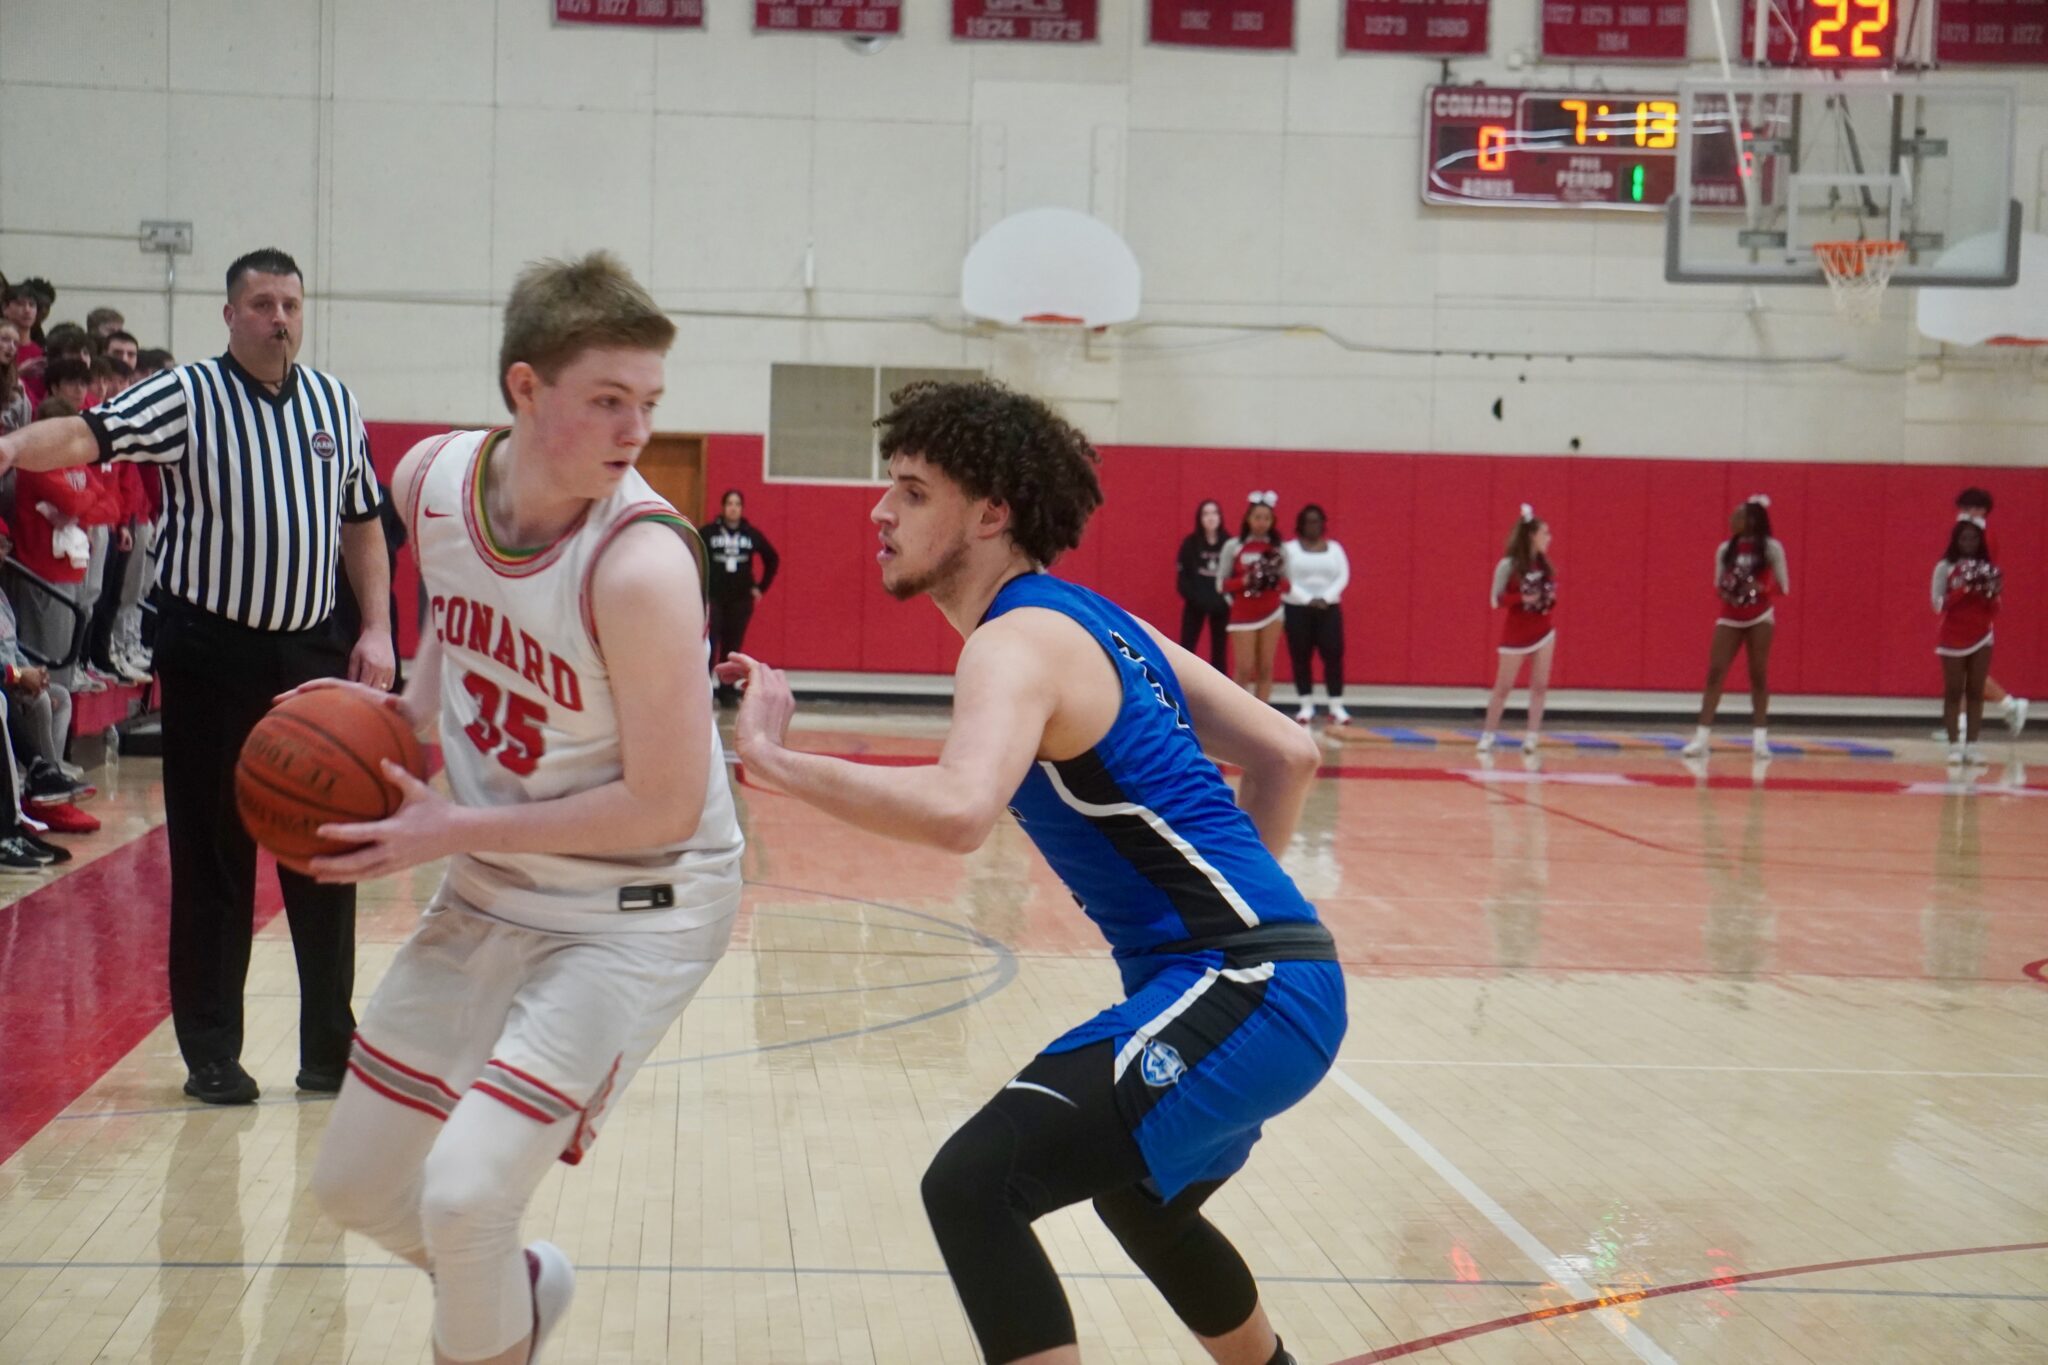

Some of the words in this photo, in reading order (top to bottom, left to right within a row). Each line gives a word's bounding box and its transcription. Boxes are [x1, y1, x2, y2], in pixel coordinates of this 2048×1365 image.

[1809, 0, 1889, 57] 22
[1435, 94, 1513, 118] CONARD
[1561, 100, 1677, 148] 7:13
[1478, 126, 1505, 171] 0
[432, 596, 584, 712] CONARD
[462, 669, 549, 778] 35
